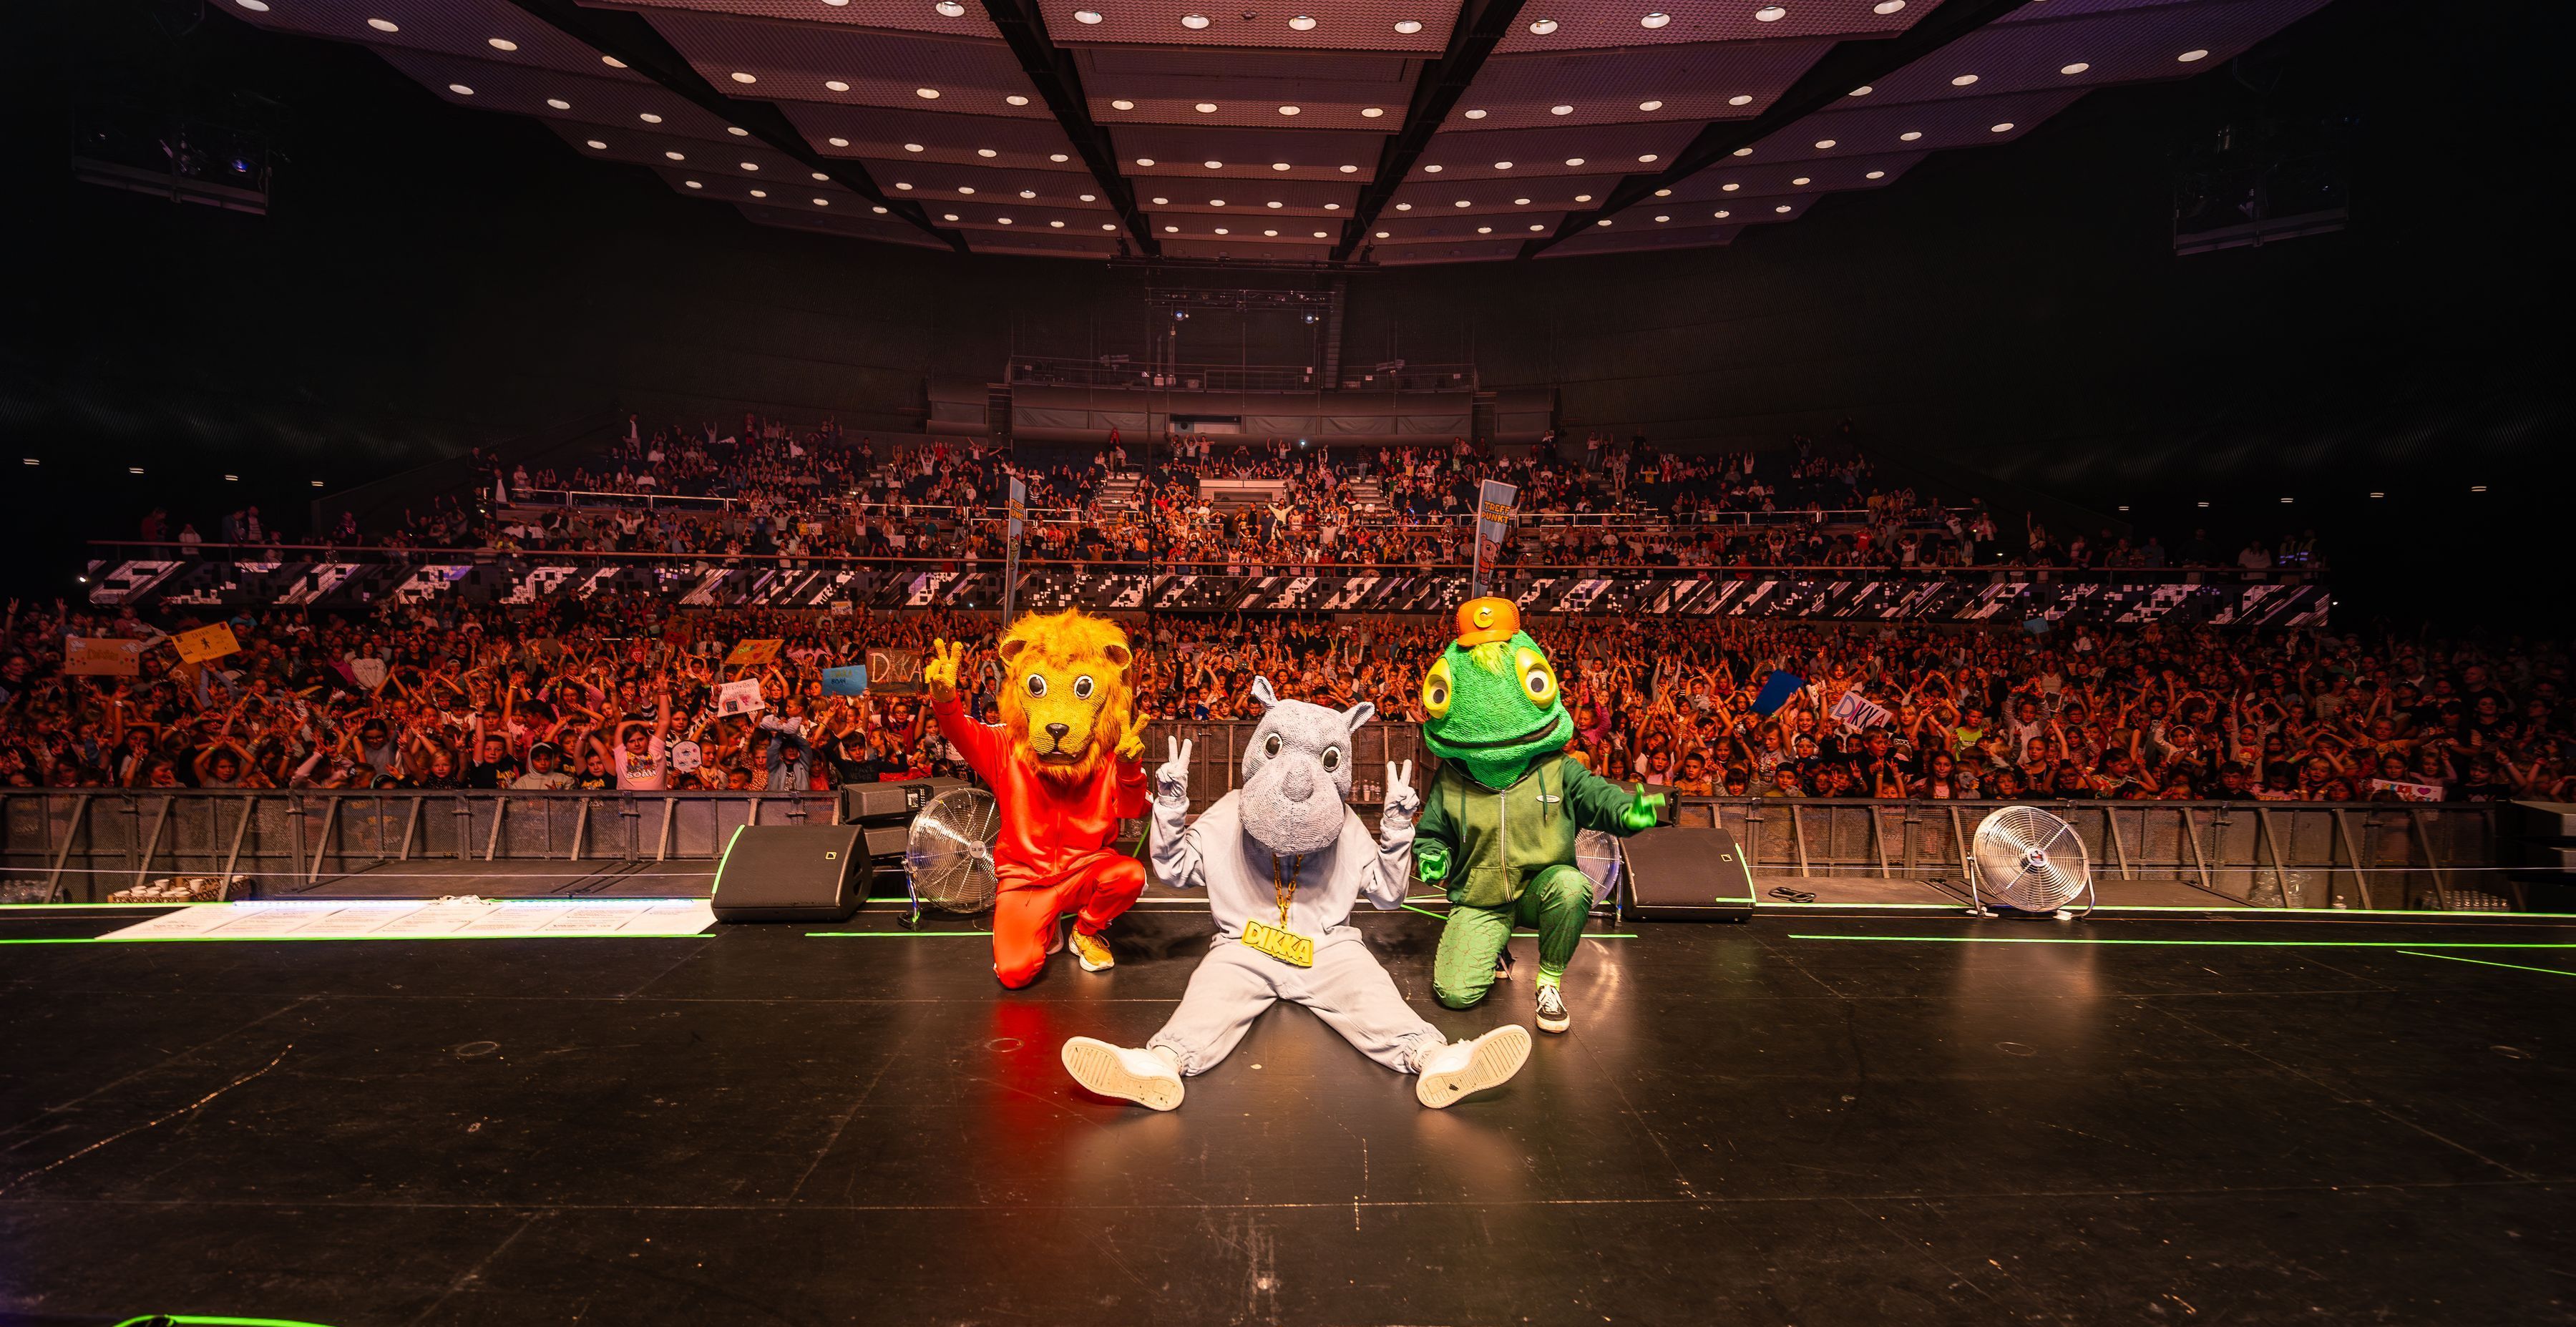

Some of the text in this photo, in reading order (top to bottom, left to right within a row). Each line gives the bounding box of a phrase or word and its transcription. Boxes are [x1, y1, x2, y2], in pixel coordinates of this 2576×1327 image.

[1481, 510, 1509, 524] PUNKT
[1484, 501, 1511, 514] TREFF
[1473, 607, 1494, 628] C
[870, 647, 922, 682] DIKKA
[1834, 695, 1886, 730] DIKKA
[1242, 919, 1313, 965] DIKKA
